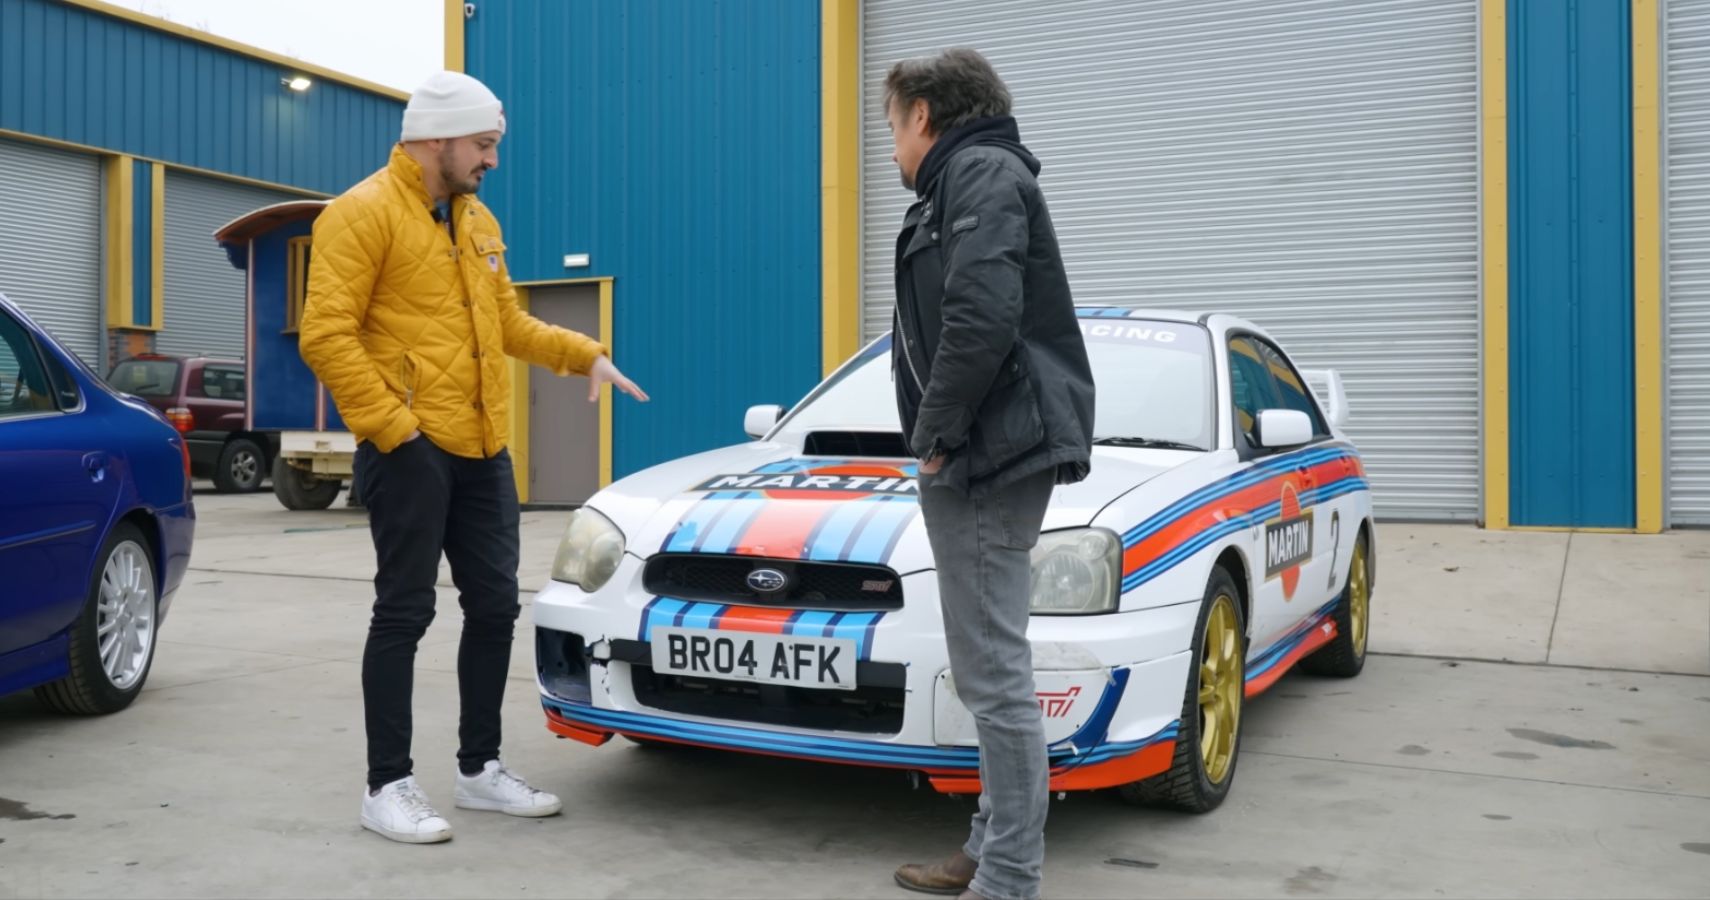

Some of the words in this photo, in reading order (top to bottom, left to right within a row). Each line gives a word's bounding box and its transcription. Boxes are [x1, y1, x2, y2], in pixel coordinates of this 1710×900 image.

[1268, 519, 1309, 568] MARTIN
[1327, 510, 1339, 592] 2
[668, 634, 758, 676] BR04
[770, 641, 841, 684] AFK
